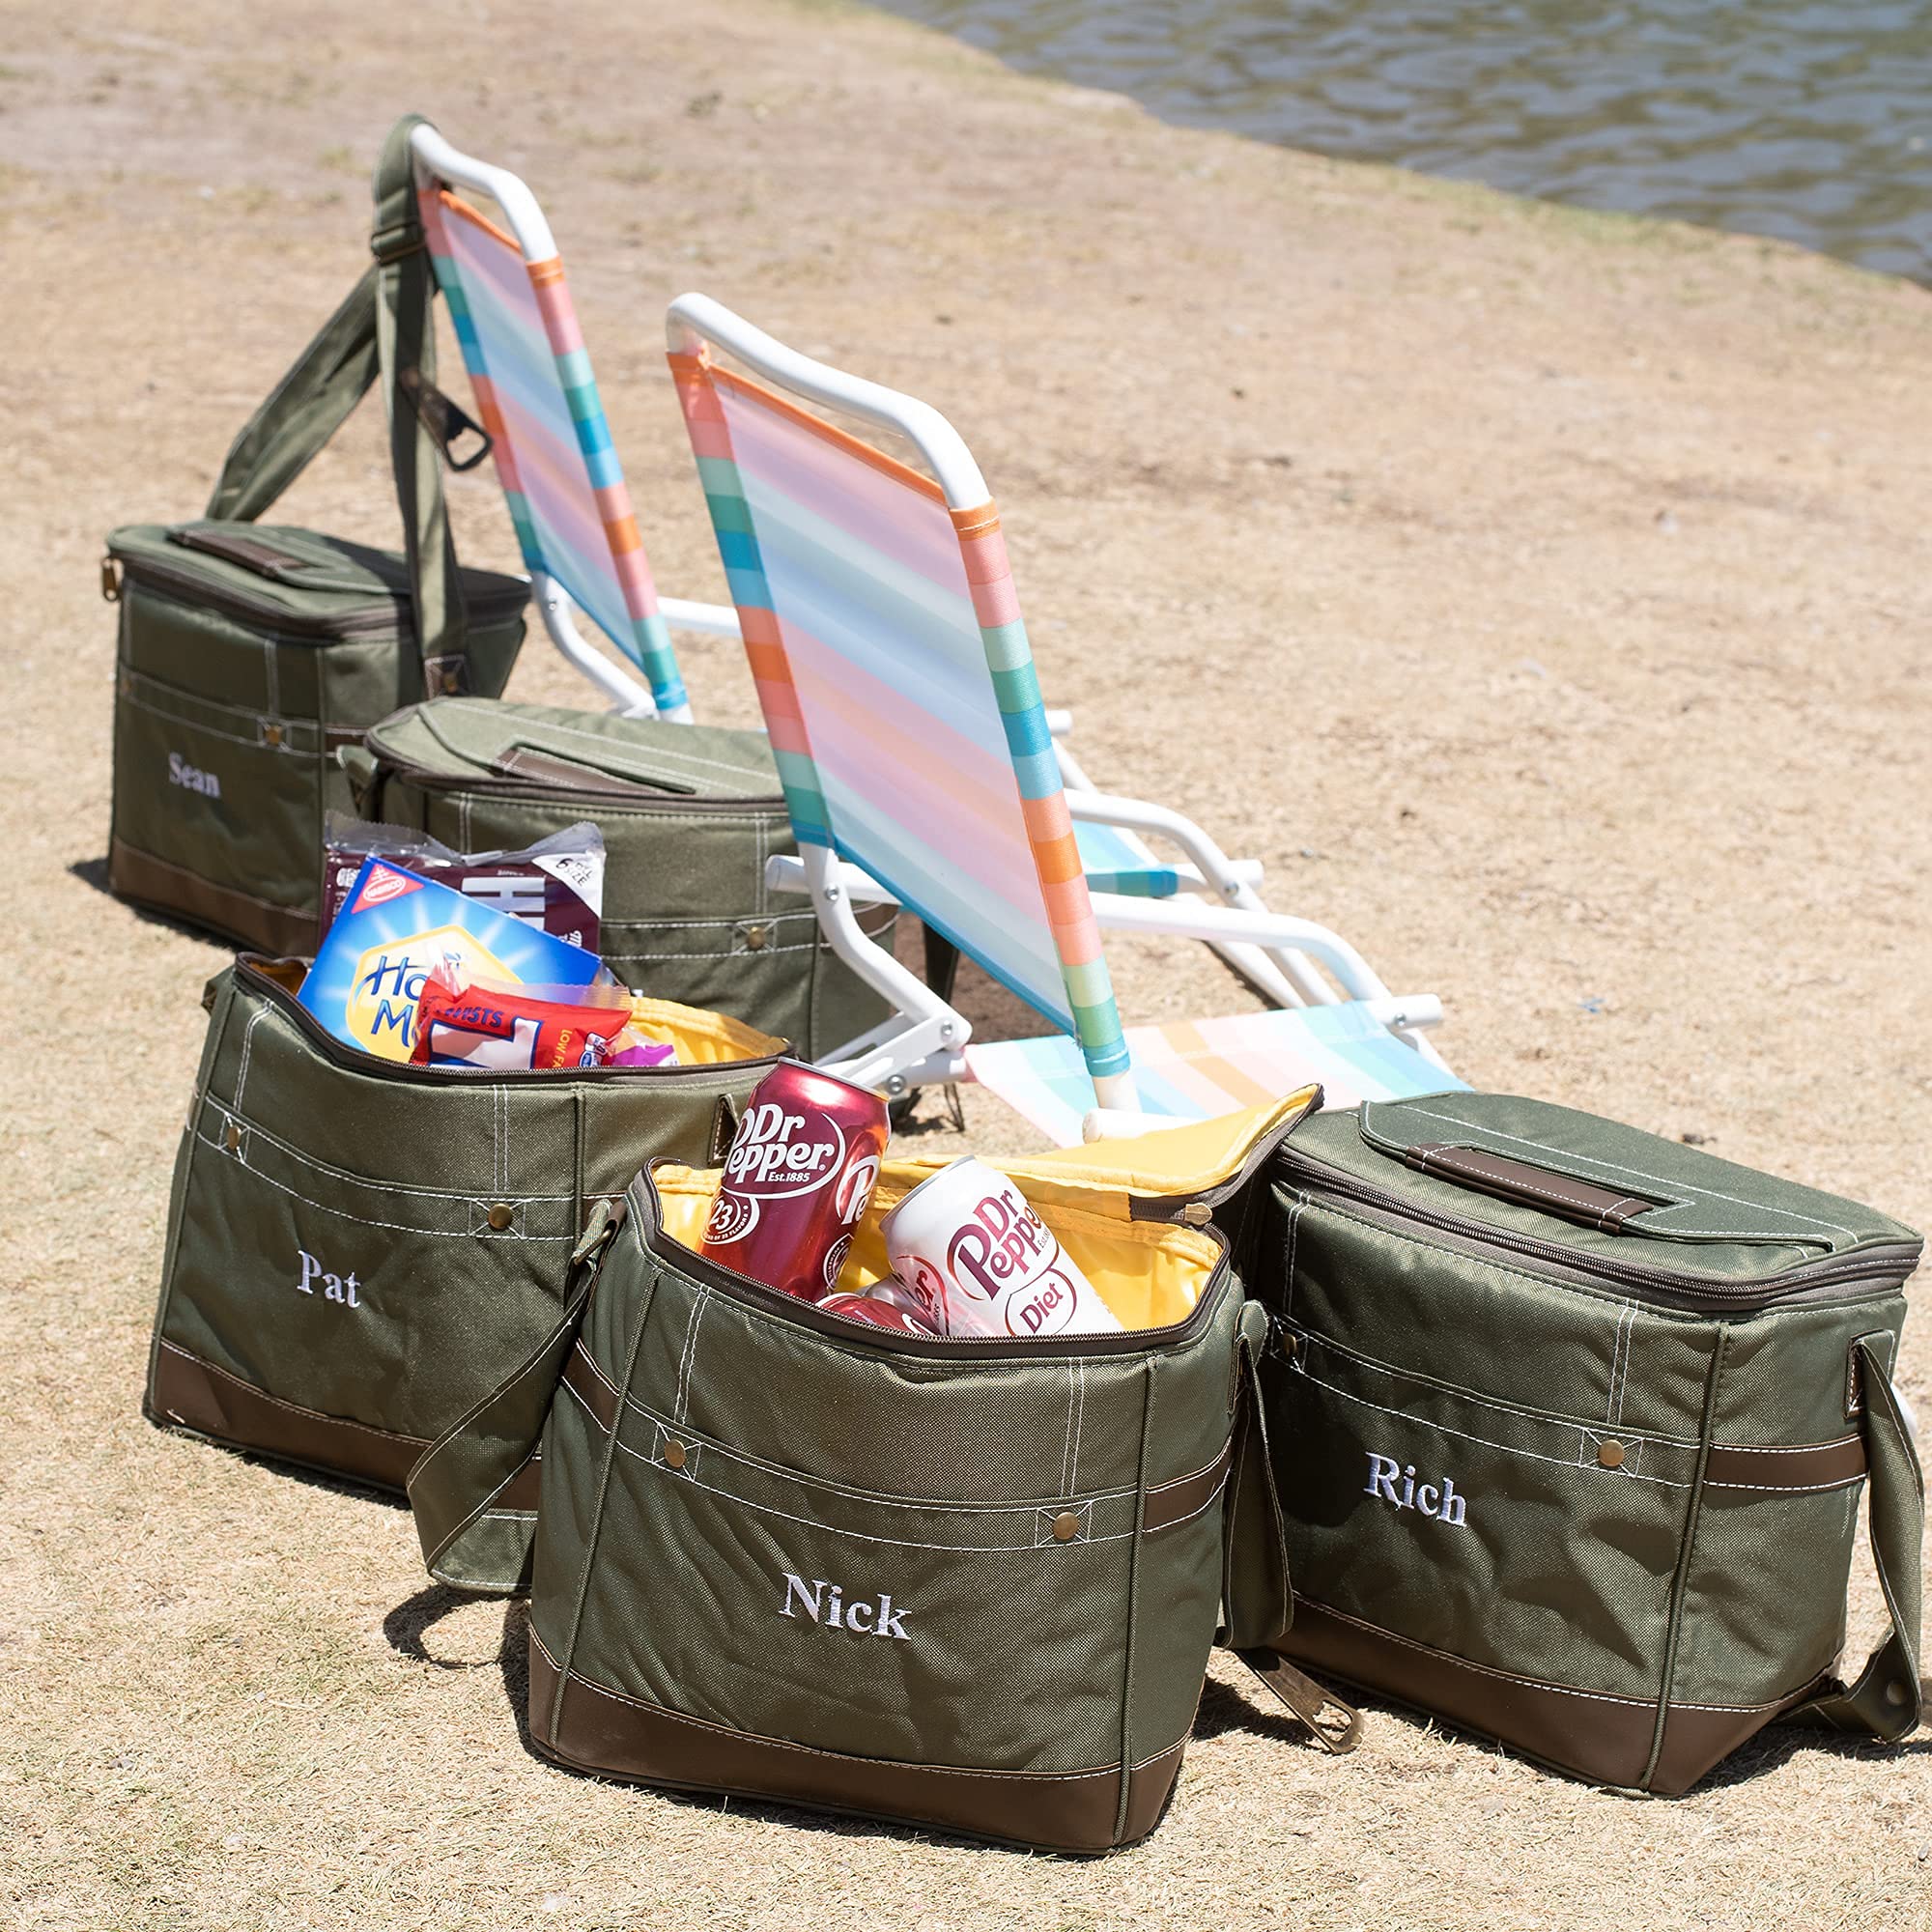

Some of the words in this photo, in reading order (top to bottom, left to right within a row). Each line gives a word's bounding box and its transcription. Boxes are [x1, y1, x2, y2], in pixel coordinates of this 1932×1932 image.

[169, 752, 220, 799] Sean
[555, 858, 573, 868] 6
[355, 955, 428, 1001] Ho
[557, 1029, 573, 1056] LOW
[747, 1103, 806, 1146] Dr
[768, 1171, 811, 1182] Est.1885
[708, 1199, 733, 1231] 23
[973, 1189, 1019, 1243] Dr
[297, 1249, 361, 1308] Pat
[1019, 1282, 1064, 1334] Diet
[1363, 1451, 1468, 1527] Rich
[778, 1576, 913, 1640] Nick
